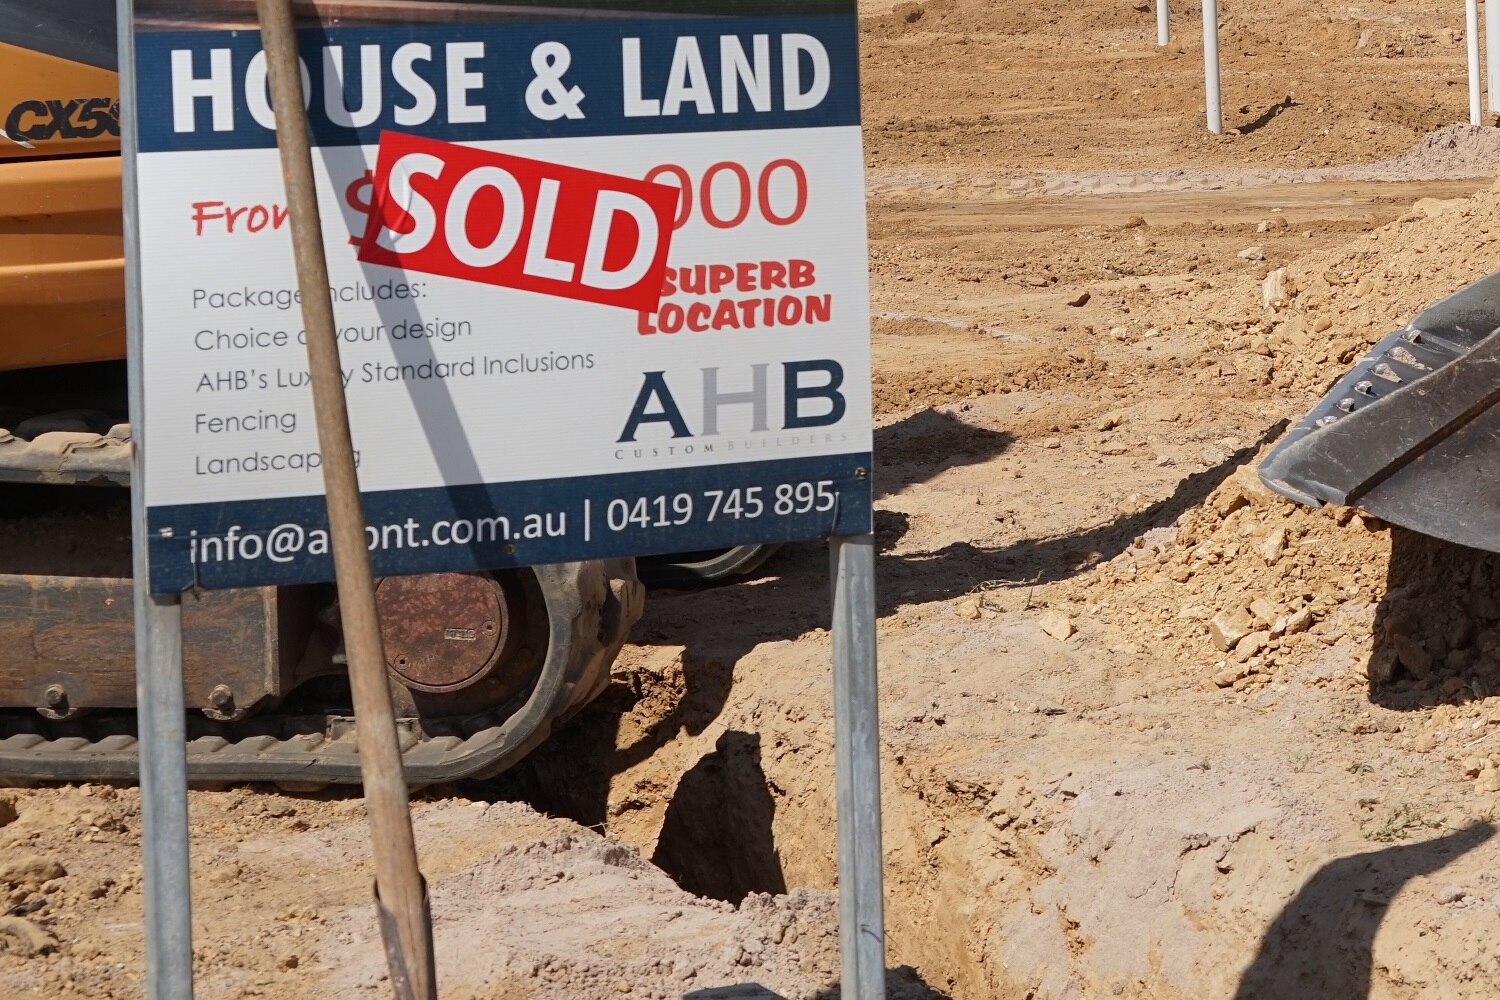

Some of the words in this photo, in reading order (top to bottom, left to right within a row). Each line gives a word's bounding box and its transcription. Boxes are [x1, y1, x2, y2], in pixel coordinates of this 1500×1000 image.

[171, 42, 486, 133] HOUSE
[525, 41, 586, 121] &
[622, 33, 831, 117] LAND
[376, 153, 659, 290] SOLD
[661, 259, 816, 297] SUPERB
[195, 328, 288, 350] Choice
[391, 318, 471, 341] design
[637, 294, 832, 335] LOCATION
[196, 369, 268, 392] AHB's
[277, 367, 354, 388] Luxy
[361, 357, 475, 383] Standard
[484, 351, 594, 375] Inclusions
[616, 359, 846, 443] AHB
[195, 410, 296, 434] Fencing
[195, 450, 360, 475] Landscap
[615, 444, 714, 460] CUSTOM
[727, 432, 848, 450] BUILDERS
[190, 511, 566, 564] info@ant.com.au
[607, 493, 693, 531] 0419
[703, 486, 764, 522] 745
[773, 480, 835, 515] 895
